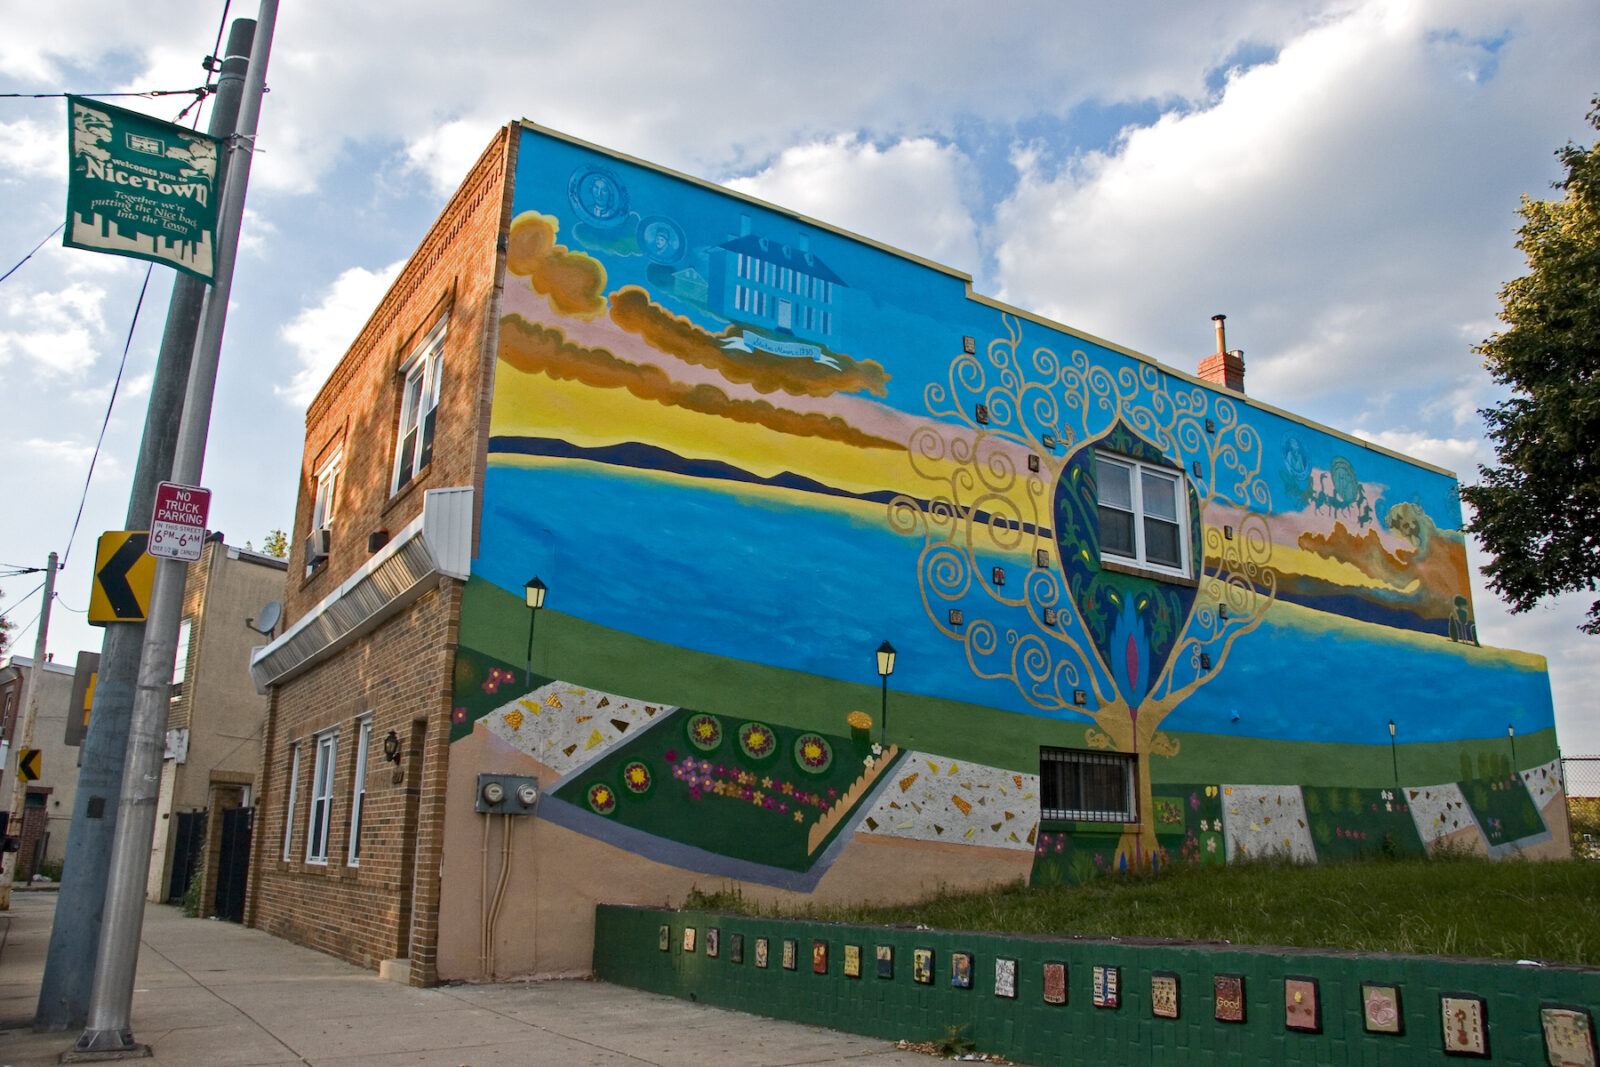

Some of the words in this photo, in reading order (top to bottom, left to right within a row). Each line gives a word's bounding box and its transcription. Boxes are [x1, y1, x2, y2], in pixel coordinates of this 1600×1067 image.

[160, 171, 176, 181] you
[114, 190, 159, 206] Together
[91, 199, 132, 211] putting
[135, 203, 151, 214] the
[154, 207, 176, 221] Nice
[142, 214, 158, 225] the
[163, 219, 188, 234] Town
[176, 490, 192, 502] NO
[165, 499, 200, 514] TRUCK
[157, 509, 203, 525] PARKING
[179, 526, 201, 534] STREET
[1216, 996, 1240, 1010] Good
